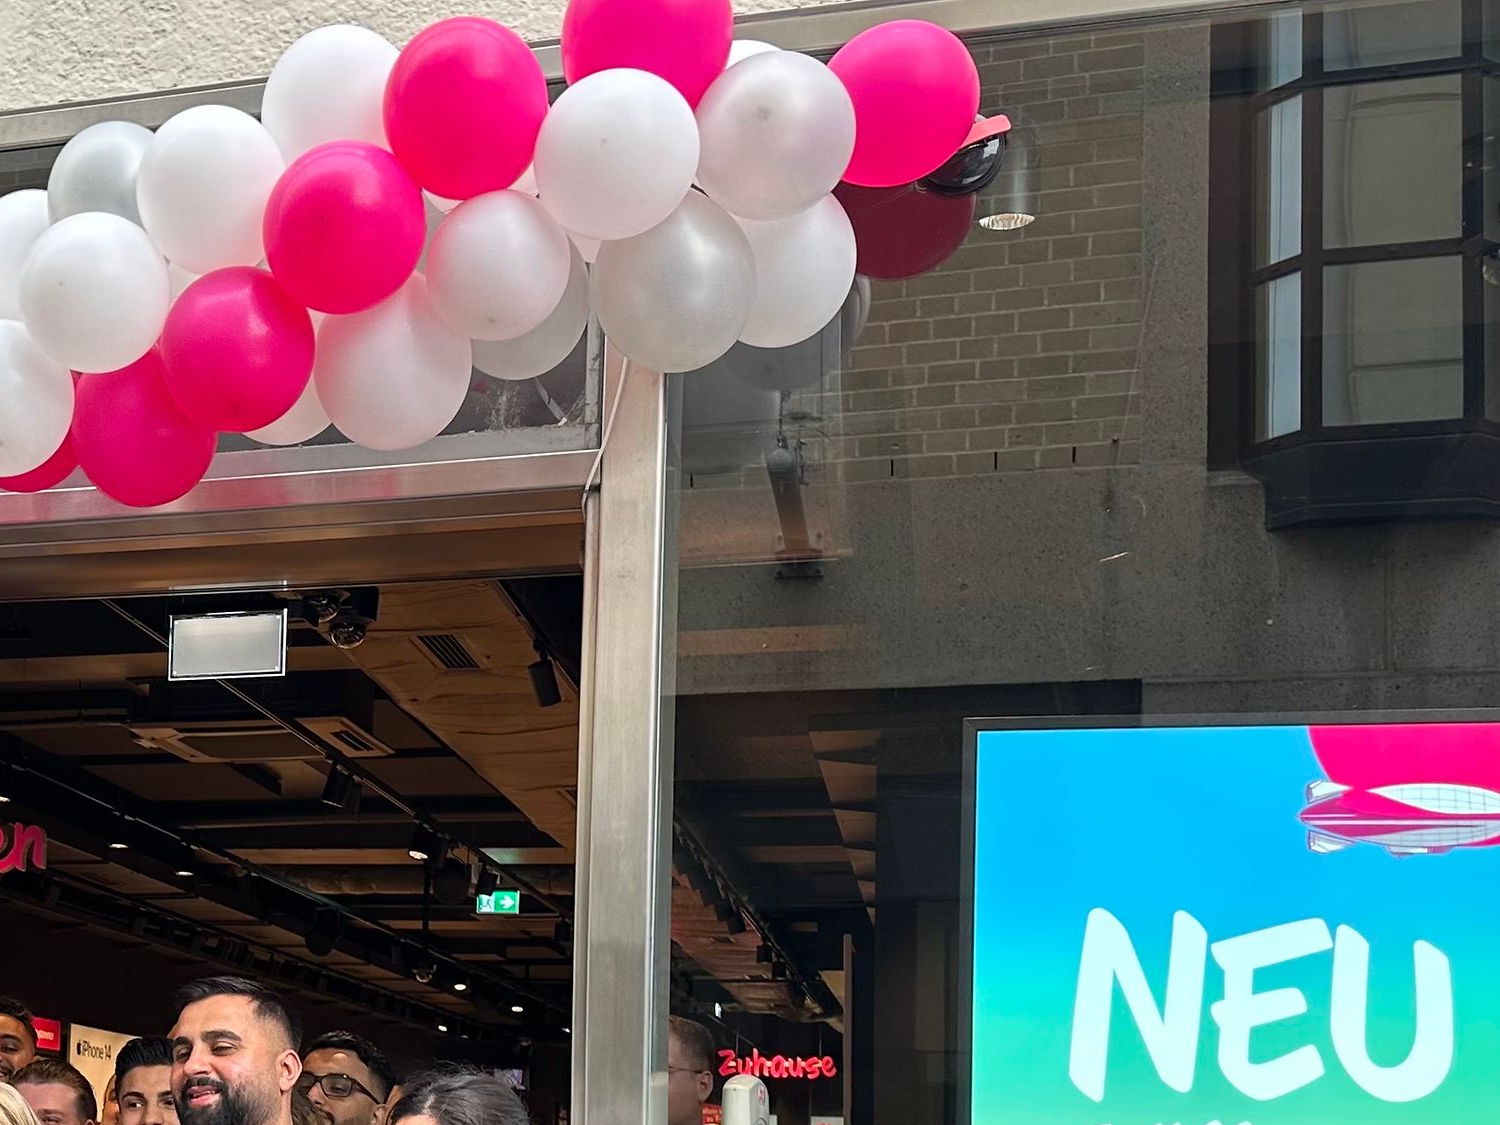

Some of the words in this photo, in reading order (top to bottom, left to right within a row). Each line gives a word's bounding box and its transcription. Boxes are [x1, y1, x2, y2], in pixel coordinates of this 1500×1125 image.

[1069, 906, 1454, 1102] NEU
[82, 1040, 103, 1059] iPhone
[104, 1044, 111, 1060] 14
[717, 1047, 837, 1080] Zuhause
